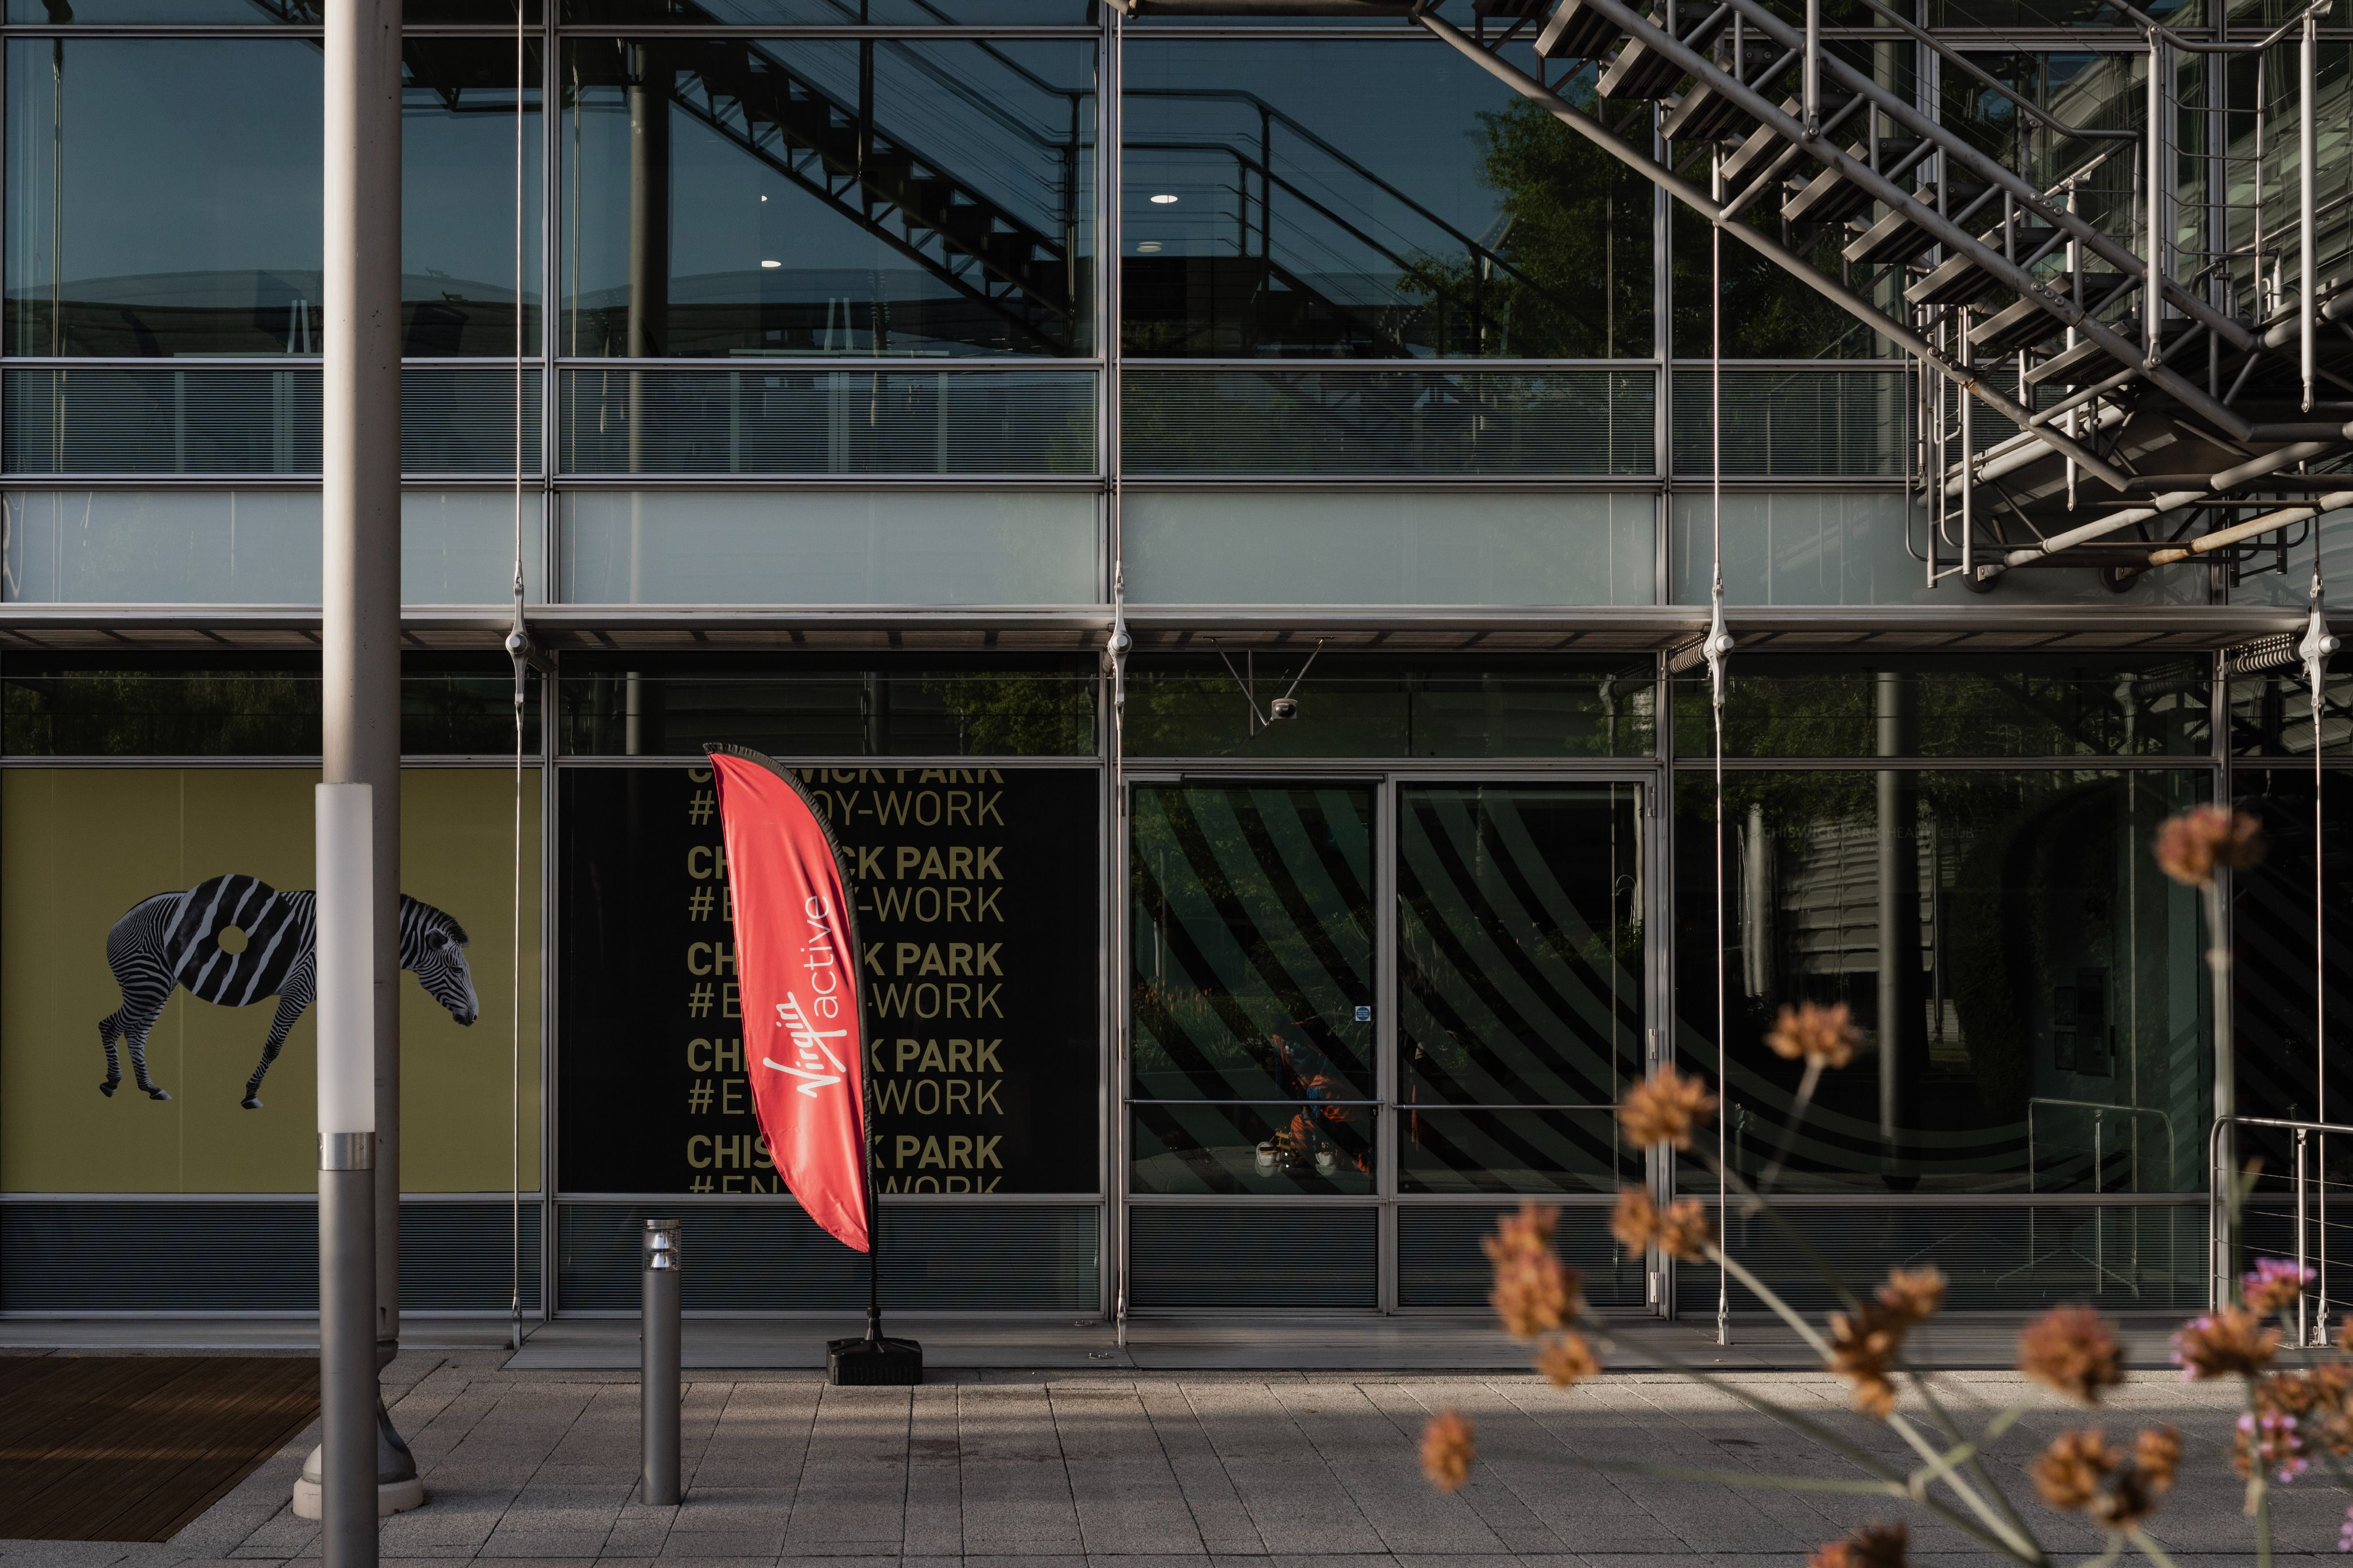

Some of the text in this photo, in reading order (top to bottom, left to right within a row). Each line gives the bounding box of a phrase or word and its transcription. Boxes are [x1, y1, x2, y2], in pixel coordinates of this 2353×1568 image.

[897, 846, 1004, 880] PARK
[896, 942, 1004, 976] PARK
[762, 894, 847, 1098] Virgin active
[896, 1038, 1003, 1072] PARK
[896, 1135, 1003, 1168] PARK
